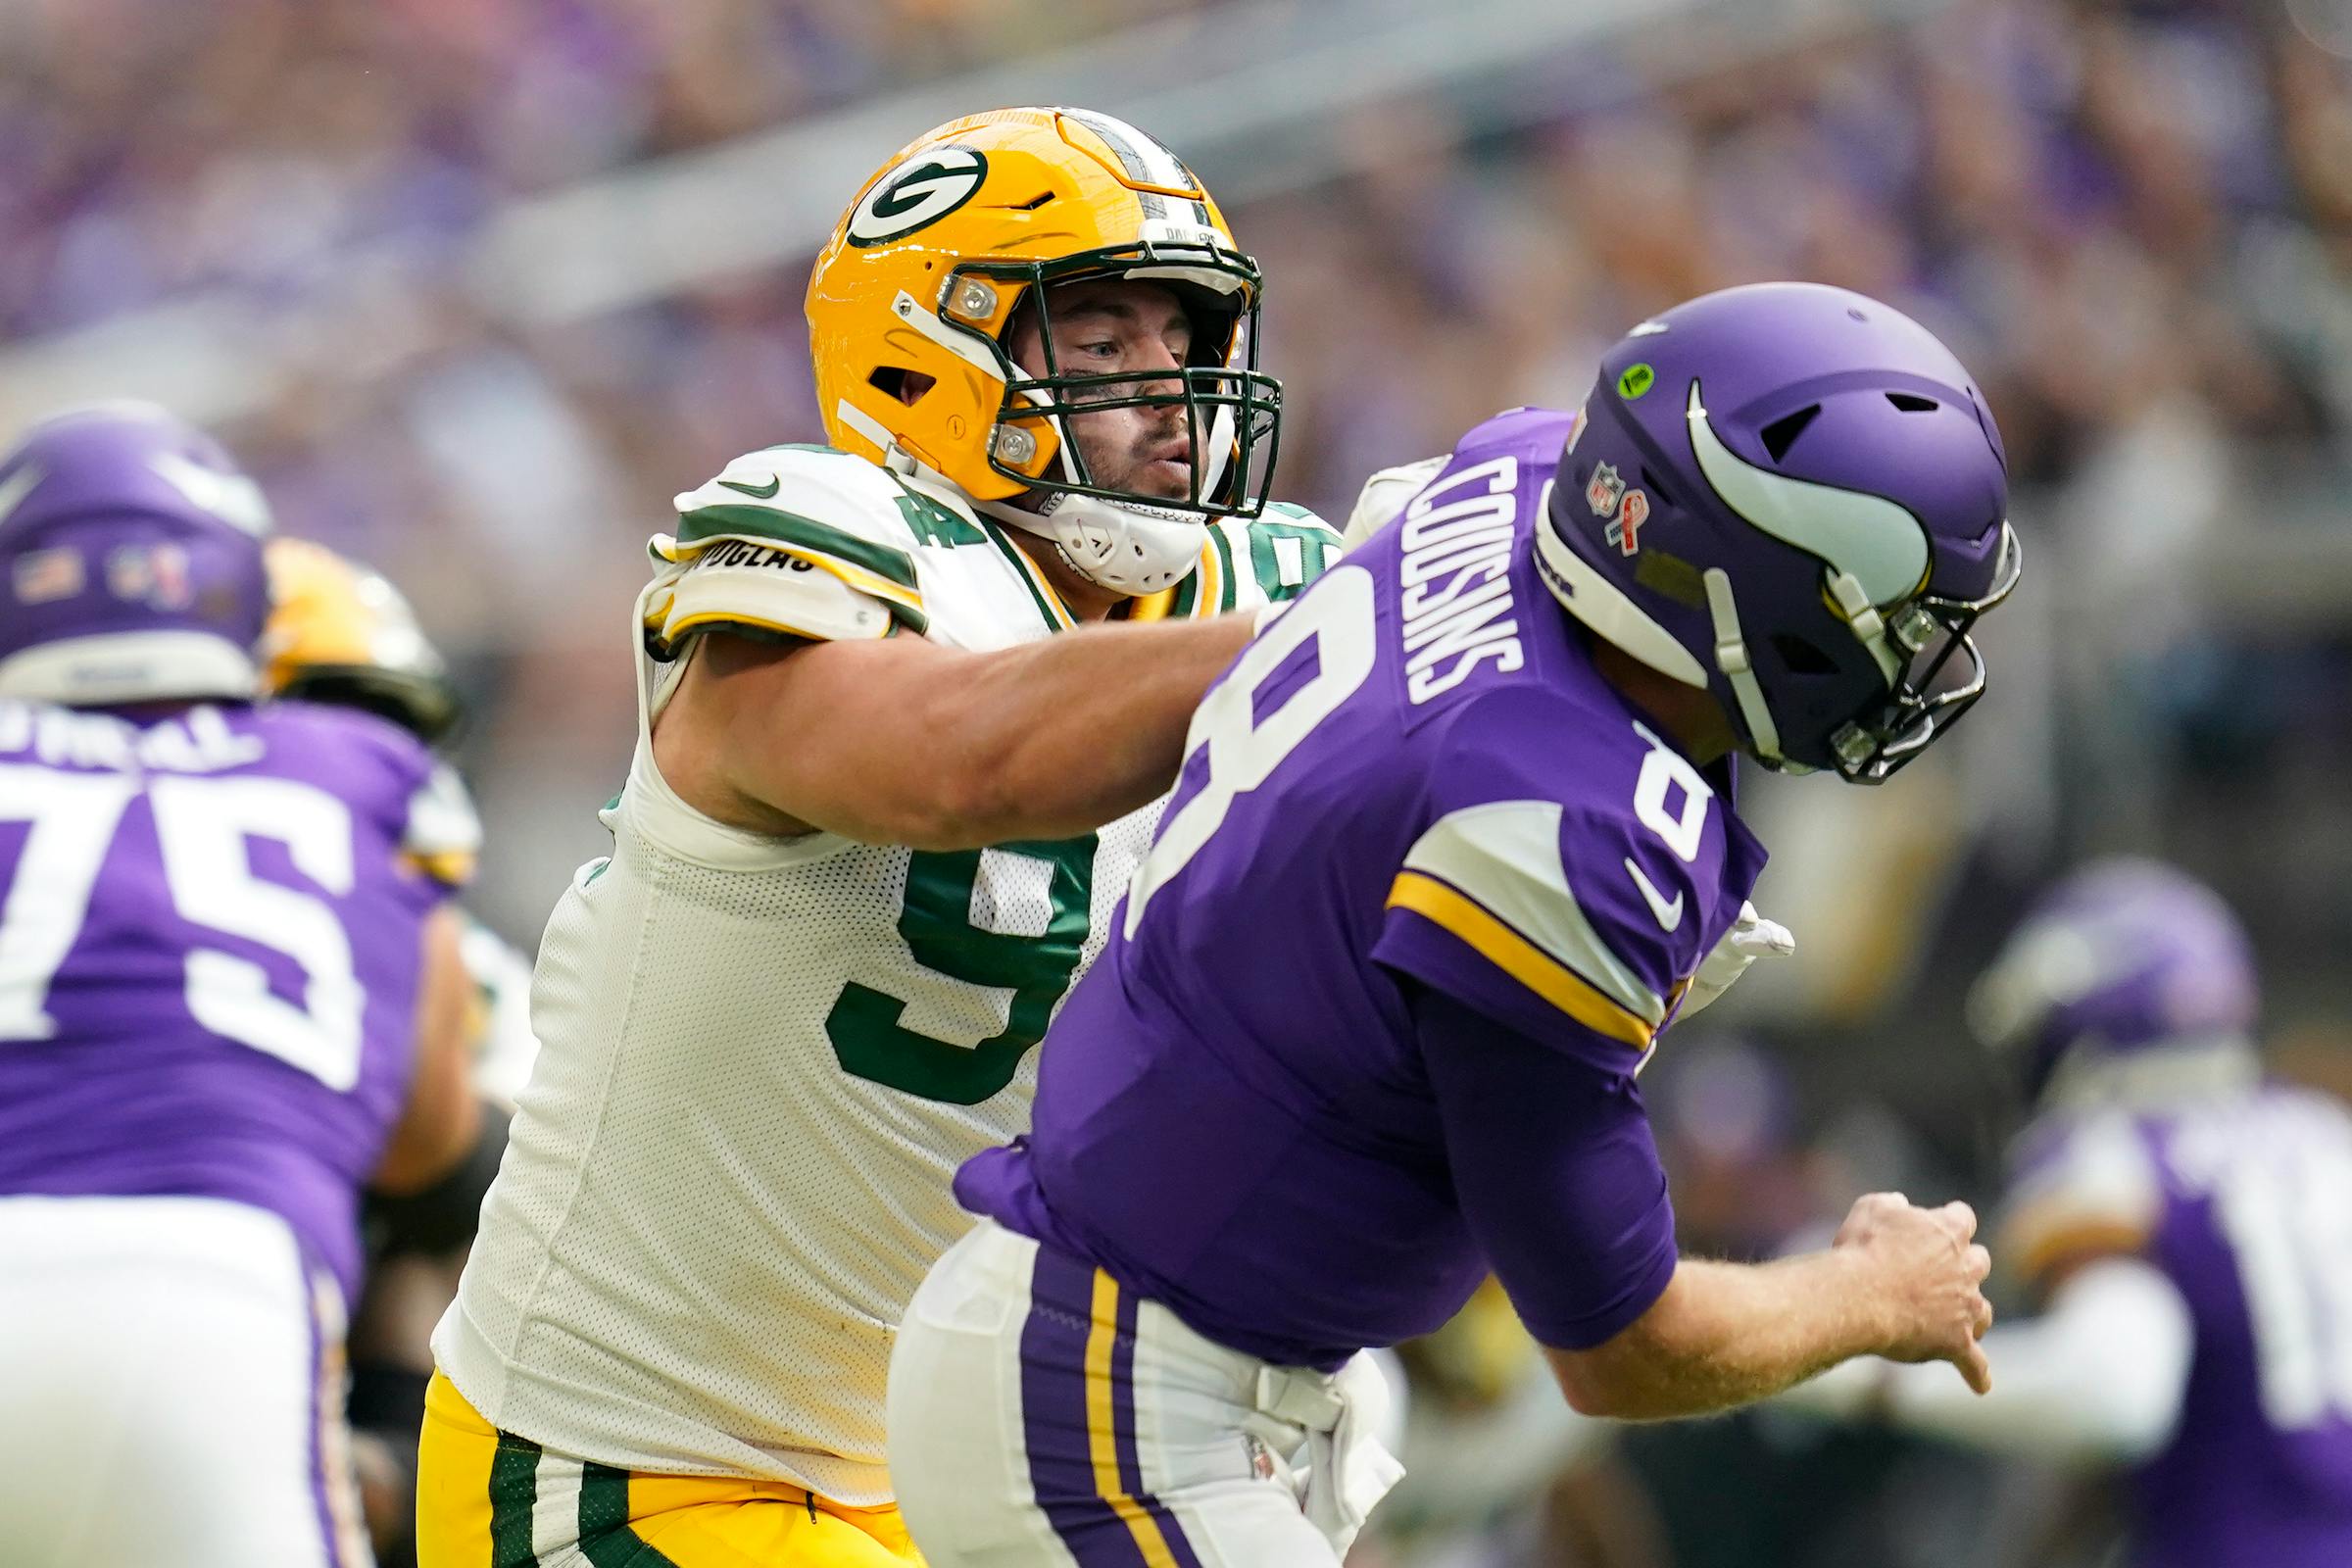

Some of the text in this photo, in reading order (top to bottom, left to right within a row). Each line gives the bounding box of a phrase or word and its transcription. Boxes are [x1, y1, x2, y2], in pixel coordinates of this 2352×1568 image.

[849, 149, 981, 240] G
[1400, 455, 1525, 706] COUSINS
[1124, 564, 1375, 942] 8
[0, 769, 367, 1094] 75
[823, 833, 1100, 1106] 9
